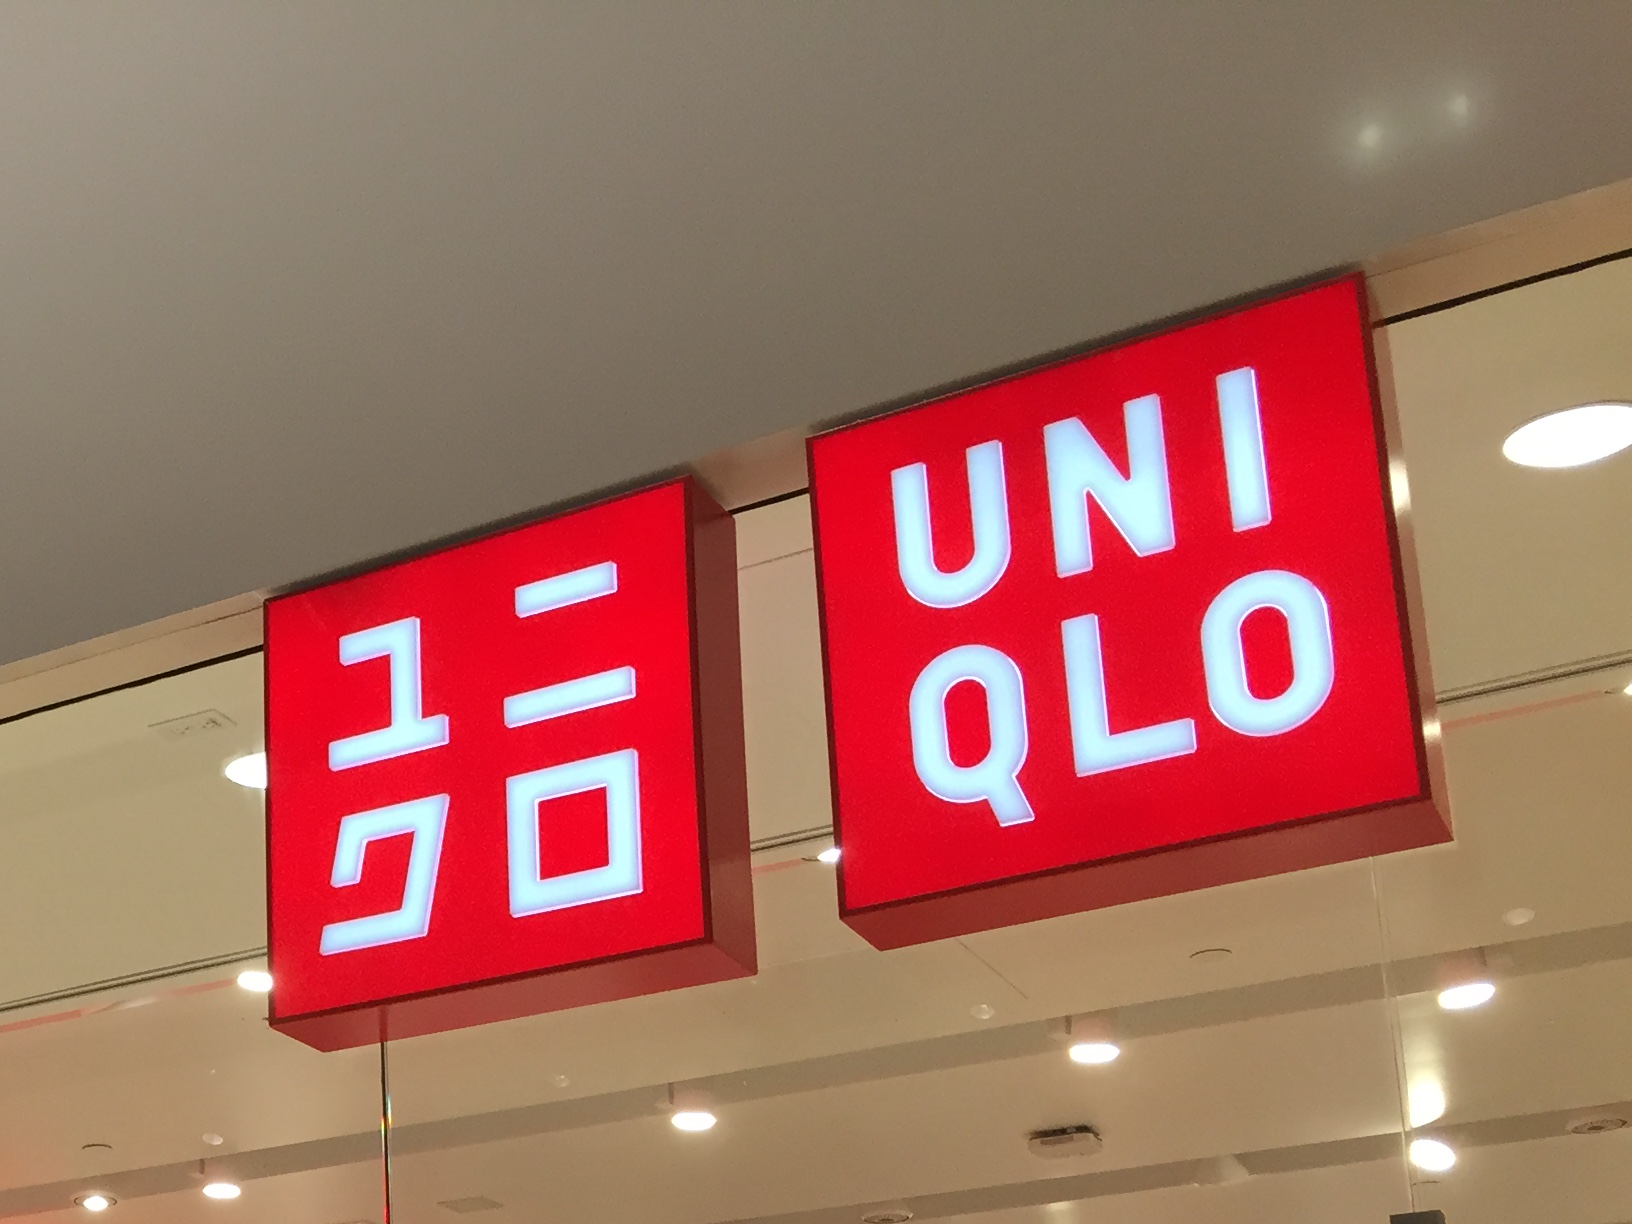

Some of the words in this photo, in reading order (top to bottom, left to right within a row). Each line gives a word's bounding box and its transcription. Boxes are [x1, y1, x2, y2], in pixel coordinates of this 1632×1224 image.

[891, 367, 1271, 609] UNI
[329, 561, 636, 772] ユニ
[910, 570, 1335, 828] QLO
[320, 748, 643, 956] クロ
